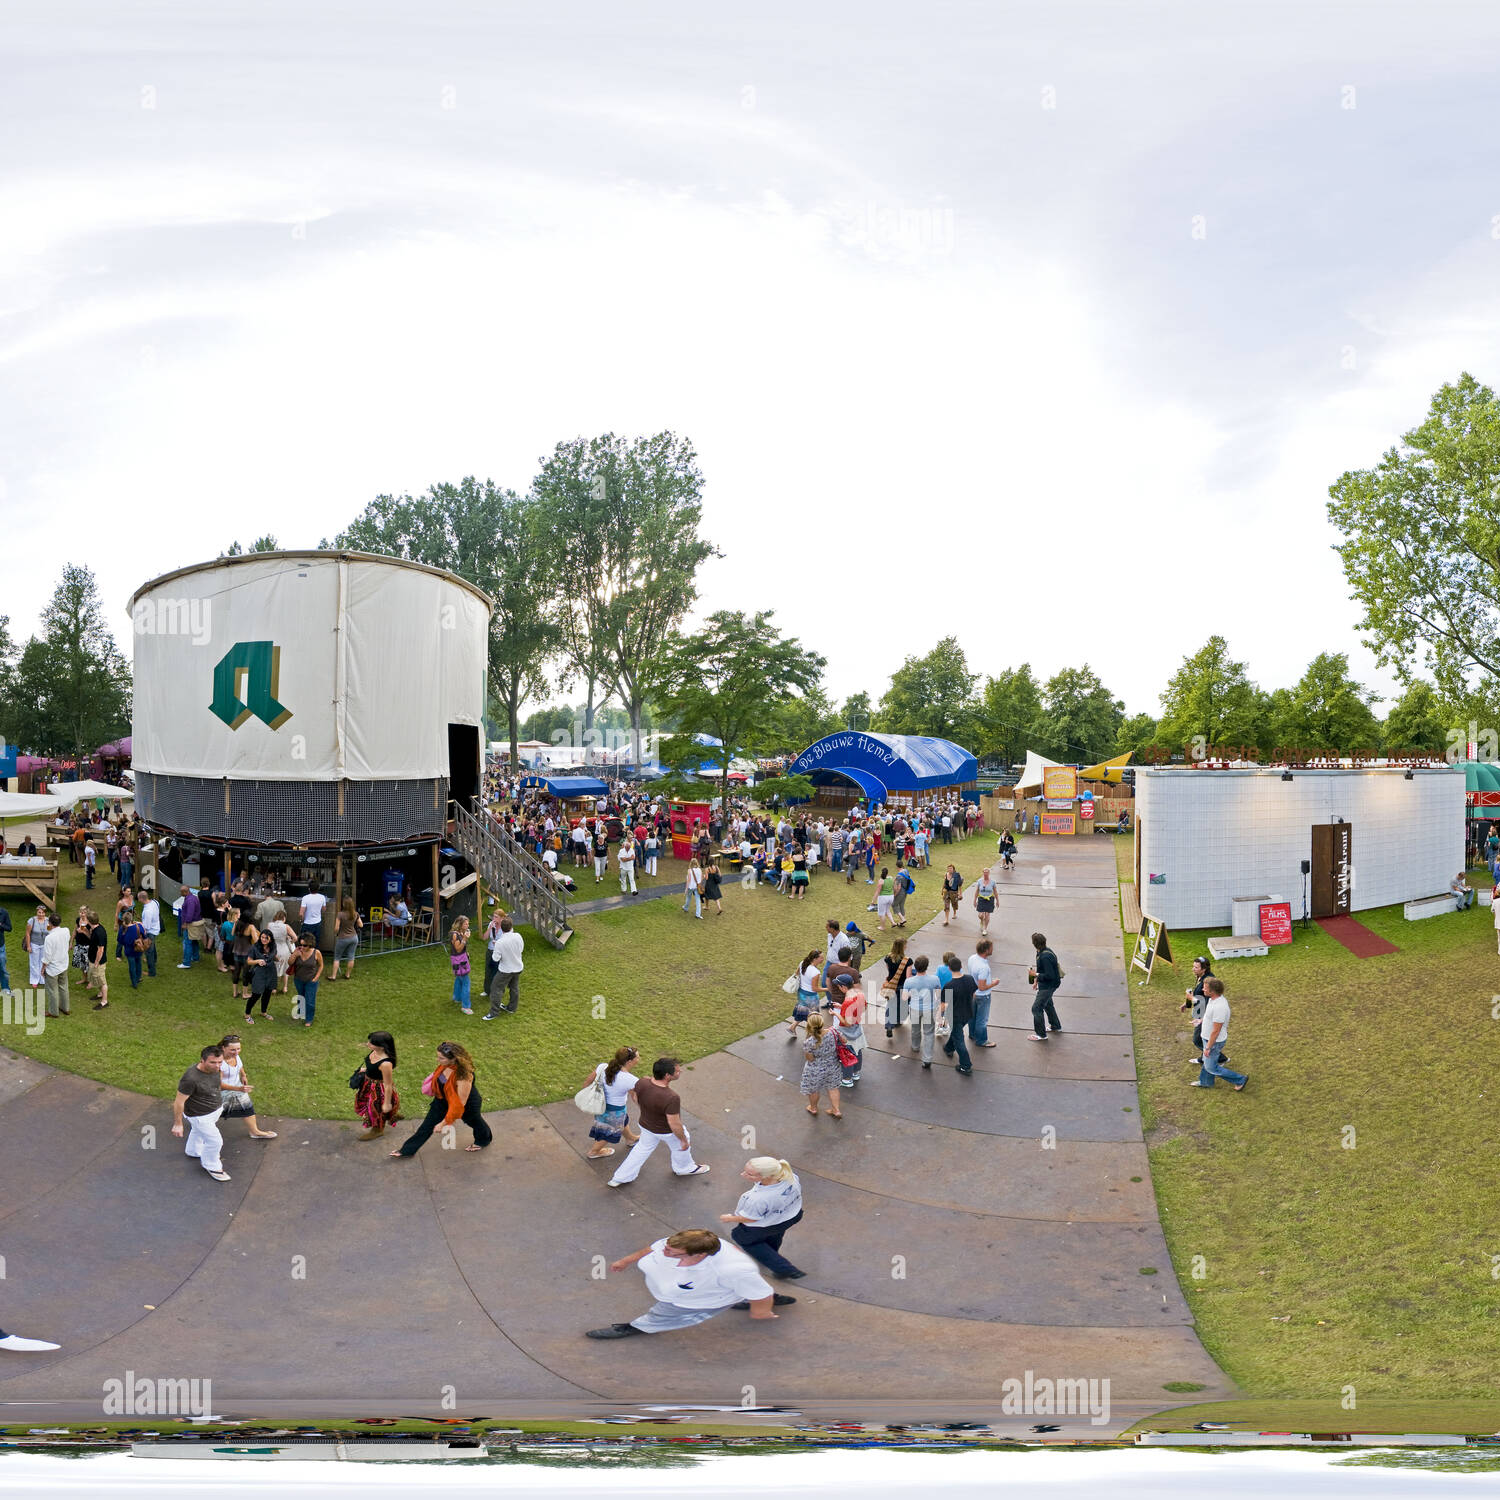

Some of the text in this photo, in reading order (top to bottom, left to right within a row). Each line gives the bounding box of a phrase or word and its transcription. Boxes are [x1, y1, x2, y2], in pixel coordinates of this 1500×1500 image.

[798, 752, 814, 769] De
[812, 735, 854, 759] Blauwe
[858, 735, 897, 767] Hemel
